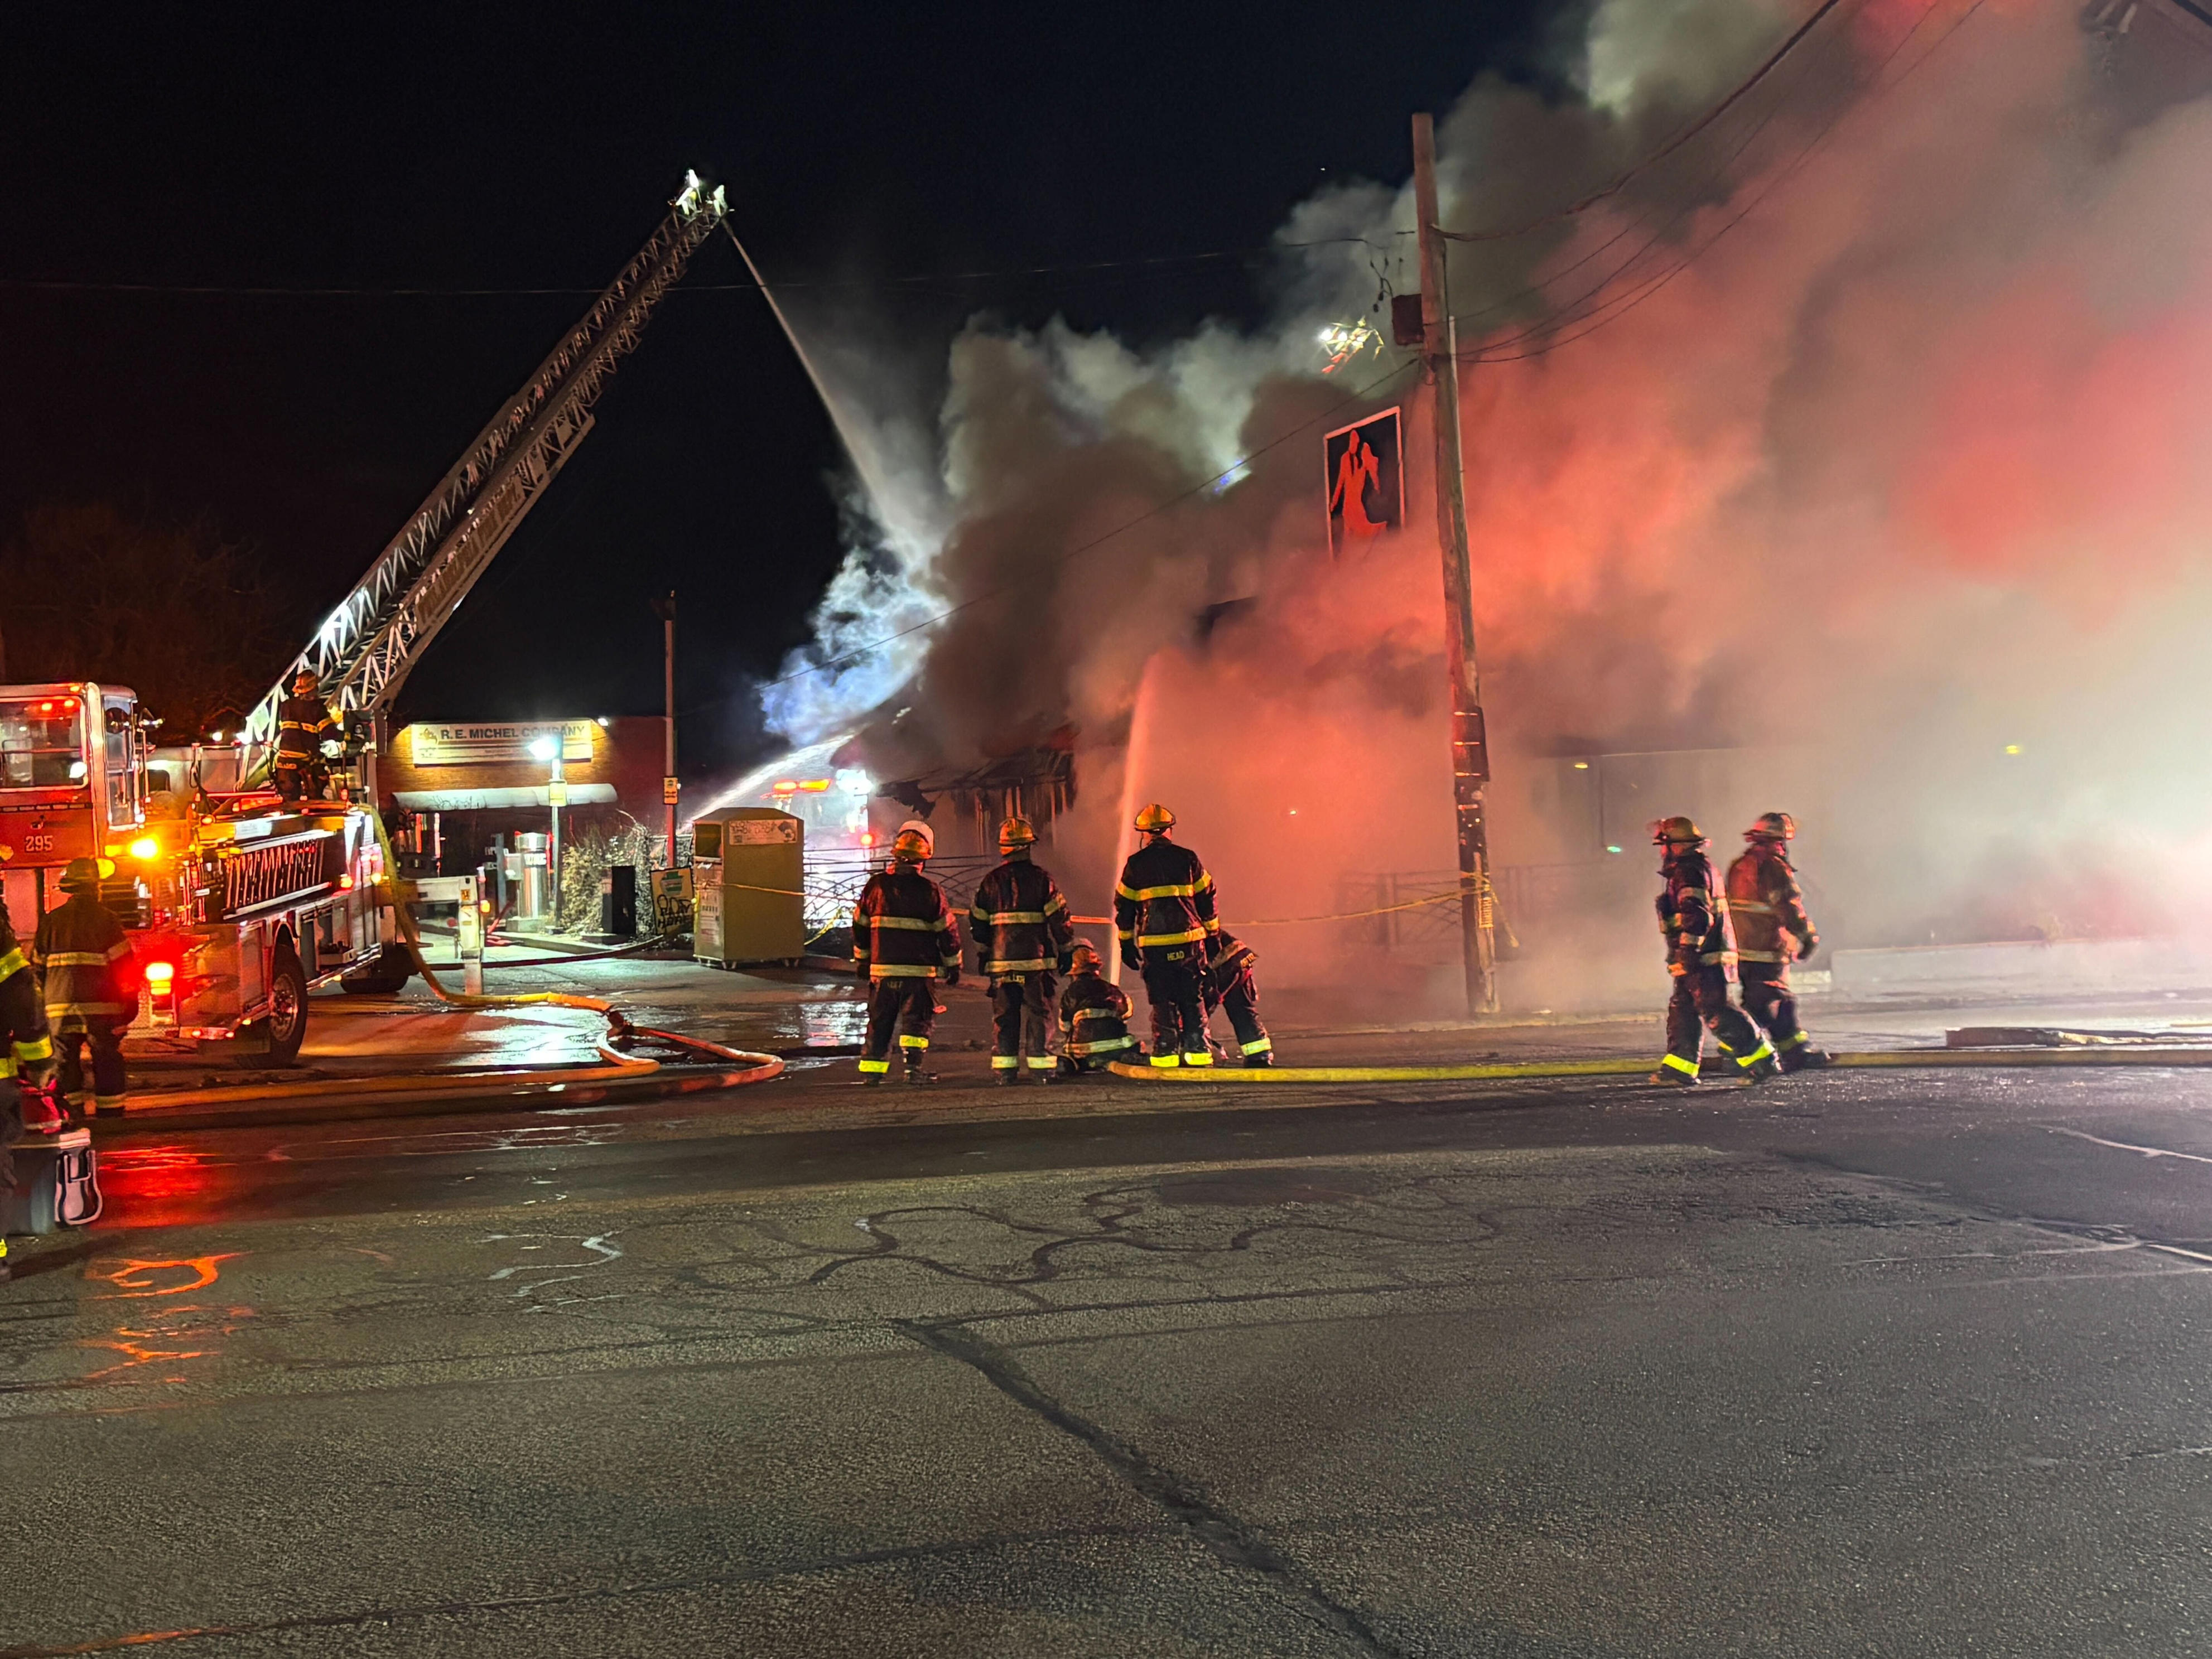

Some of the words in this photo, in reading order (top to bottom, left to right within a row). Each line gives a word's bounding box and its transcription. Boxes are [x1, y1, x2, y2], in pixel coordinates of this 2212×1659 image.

[469, 728, 519, 739] MICHEL
[25, 835, 54, 851] 295
[1167, 951, 1185, 961] HEAD
